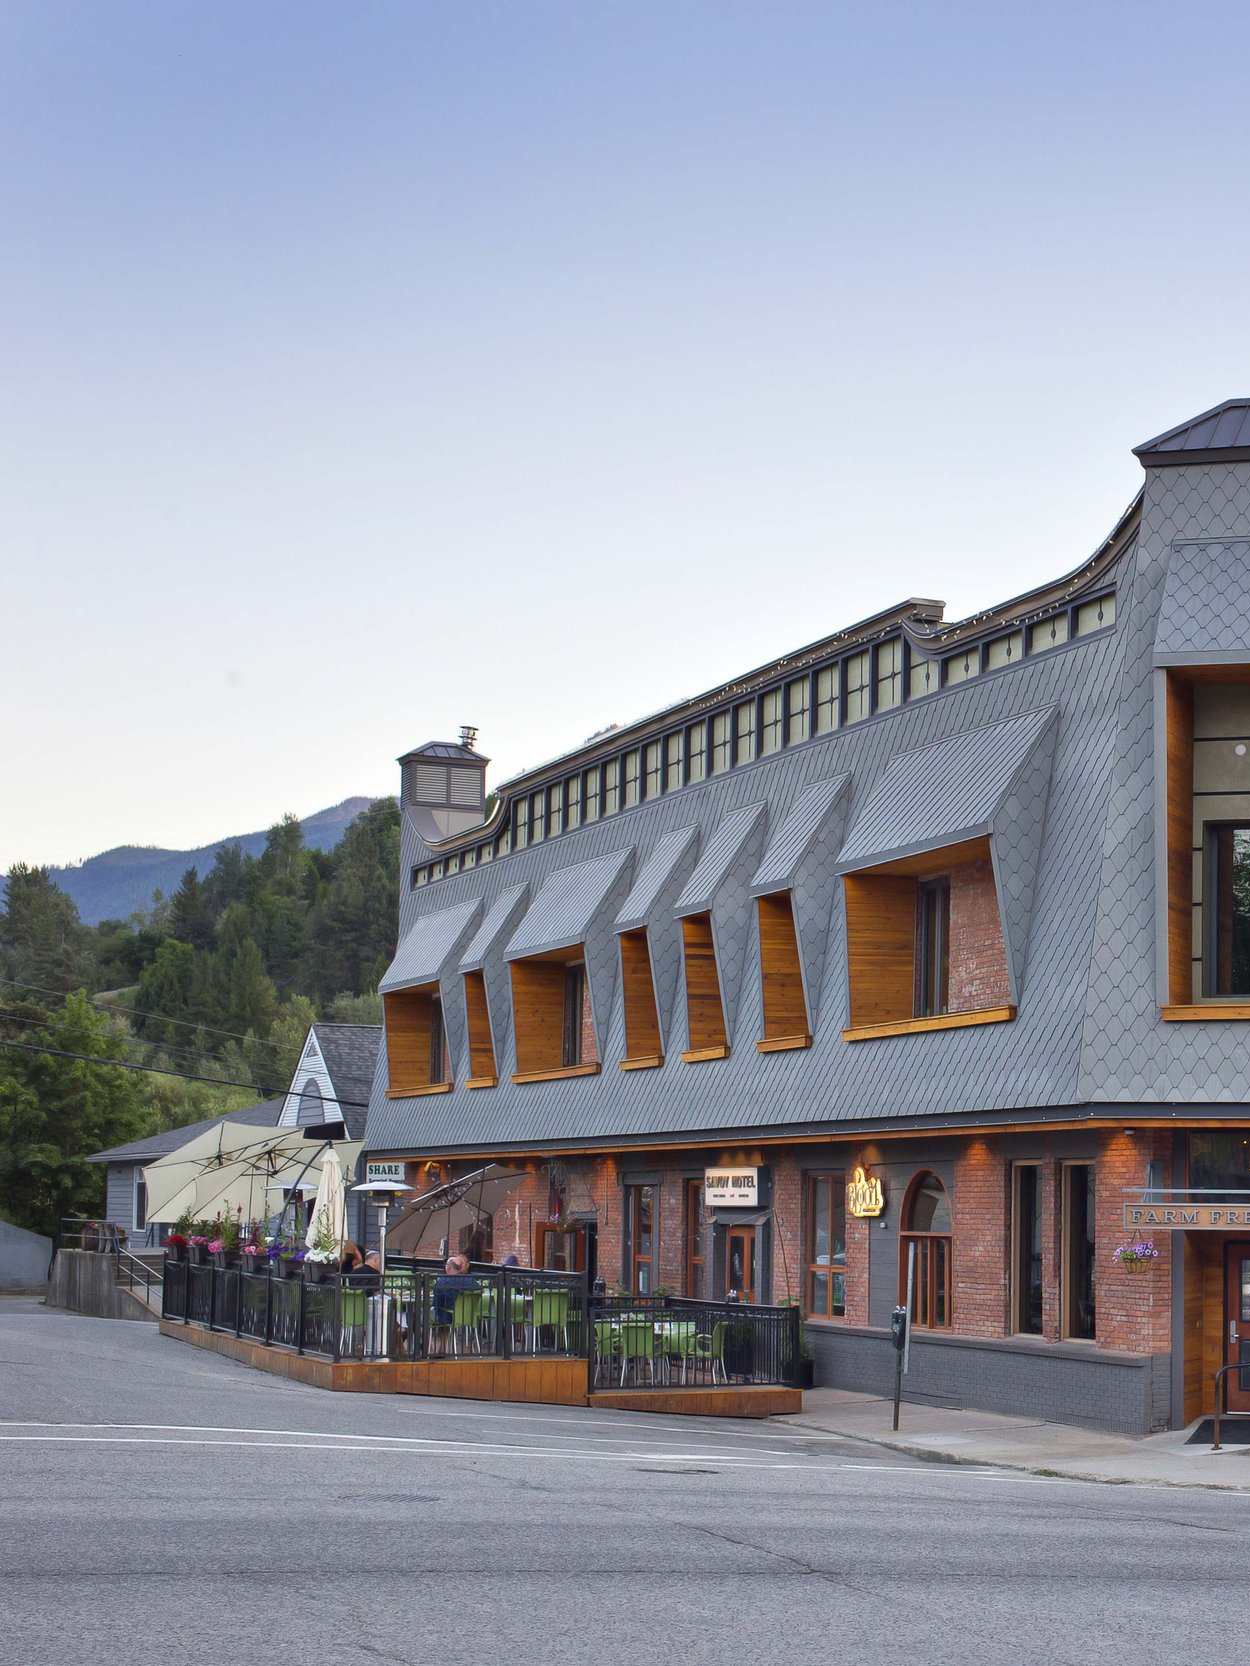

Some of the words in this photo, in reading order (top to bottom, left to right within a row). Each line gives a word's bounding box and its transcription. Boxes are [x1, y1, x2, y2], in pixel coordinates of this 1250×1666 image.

[368, 1164, 400, 1175] SHARE
[706, 1175, 730, 1188] SAVOY
[731, 1175, 756, 1188] HOTEL
[1131, 1209, 1199, 1224] FARM
